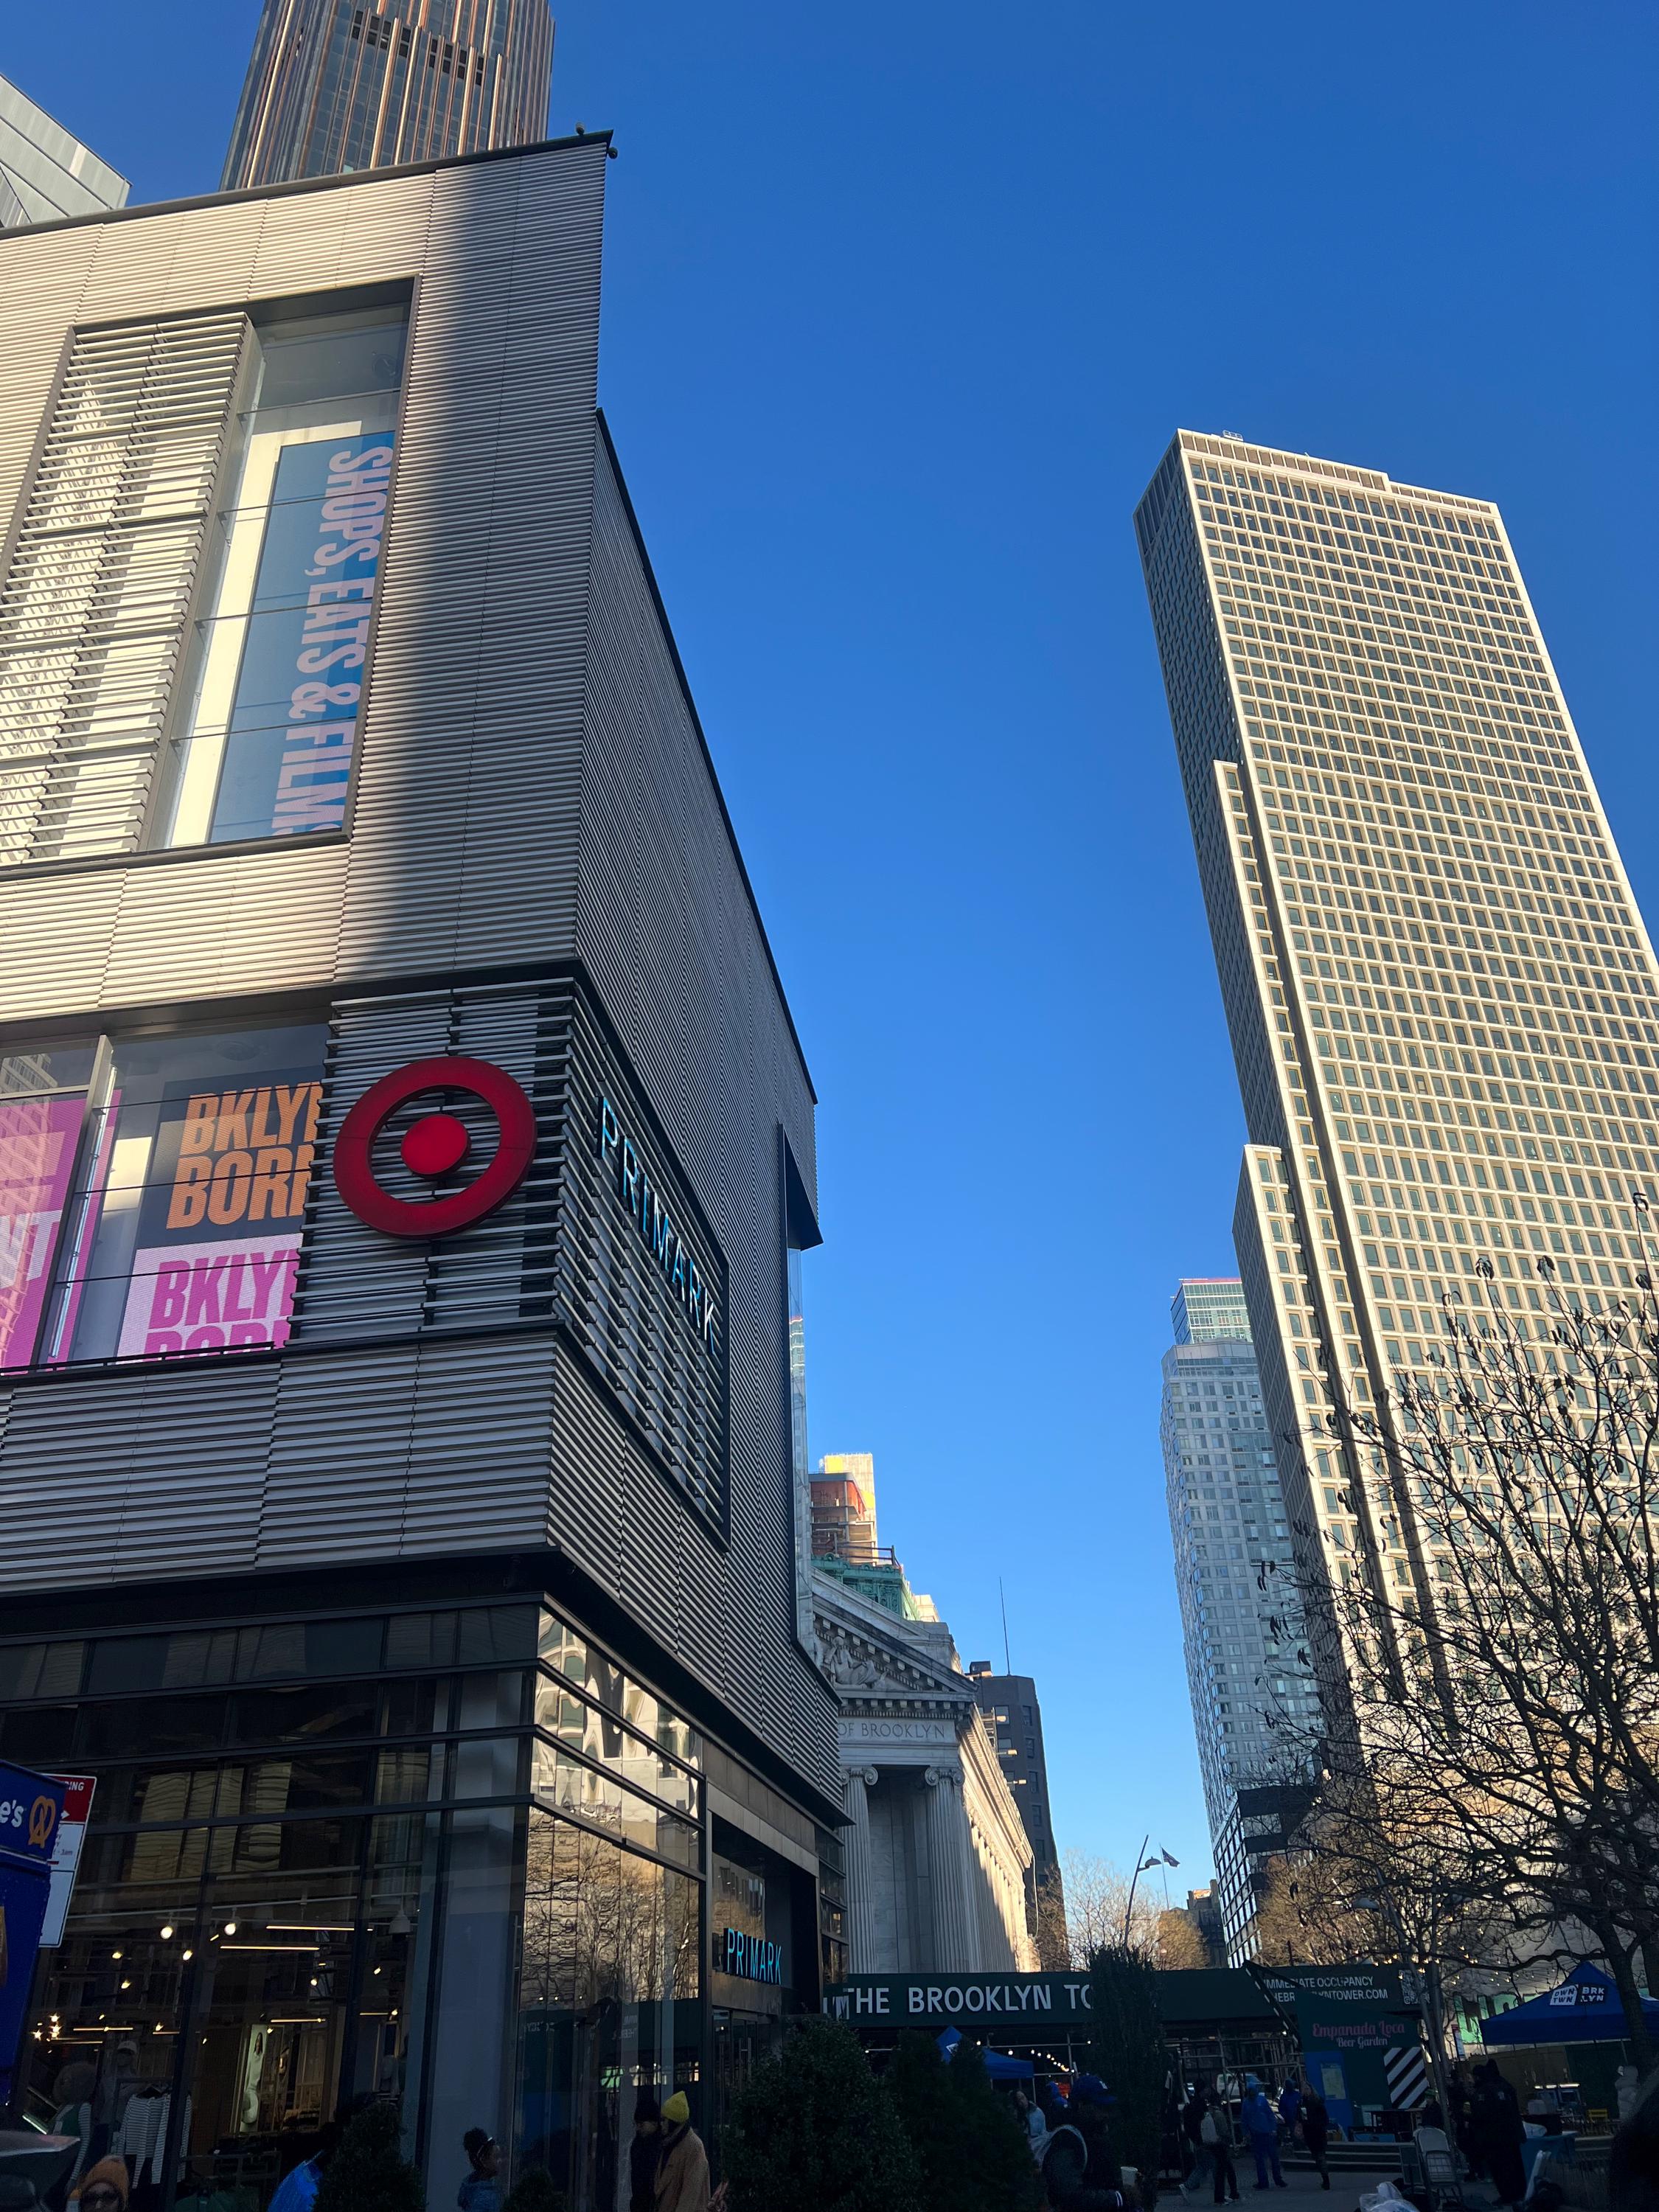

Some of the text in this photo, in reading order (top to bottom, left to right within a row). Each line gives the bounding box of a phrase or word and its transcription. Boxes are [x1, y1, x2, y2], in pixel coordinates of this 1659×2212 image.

[272, 445, 394, 835] SHOPS, EATS & FILM
[597, 1096, 714, 1354] PRIMARK
[838, 1722, 945, 1739] OF BROOKLYN
[726, 1927, 782, 1985] PRIMARK
[1317, 1976, 1374, 1988] OCCUPANCY
[1582, 1986, 1605, 1994] BRK
[908, 1984, 1052, 2014] BROOKLYN
[1581, 1994, 1604, 2003] LYN
[1312, 2020, 1405, 2039] Empanada Loca
[1336, 2037, 1388, 2049] Beer Garden
